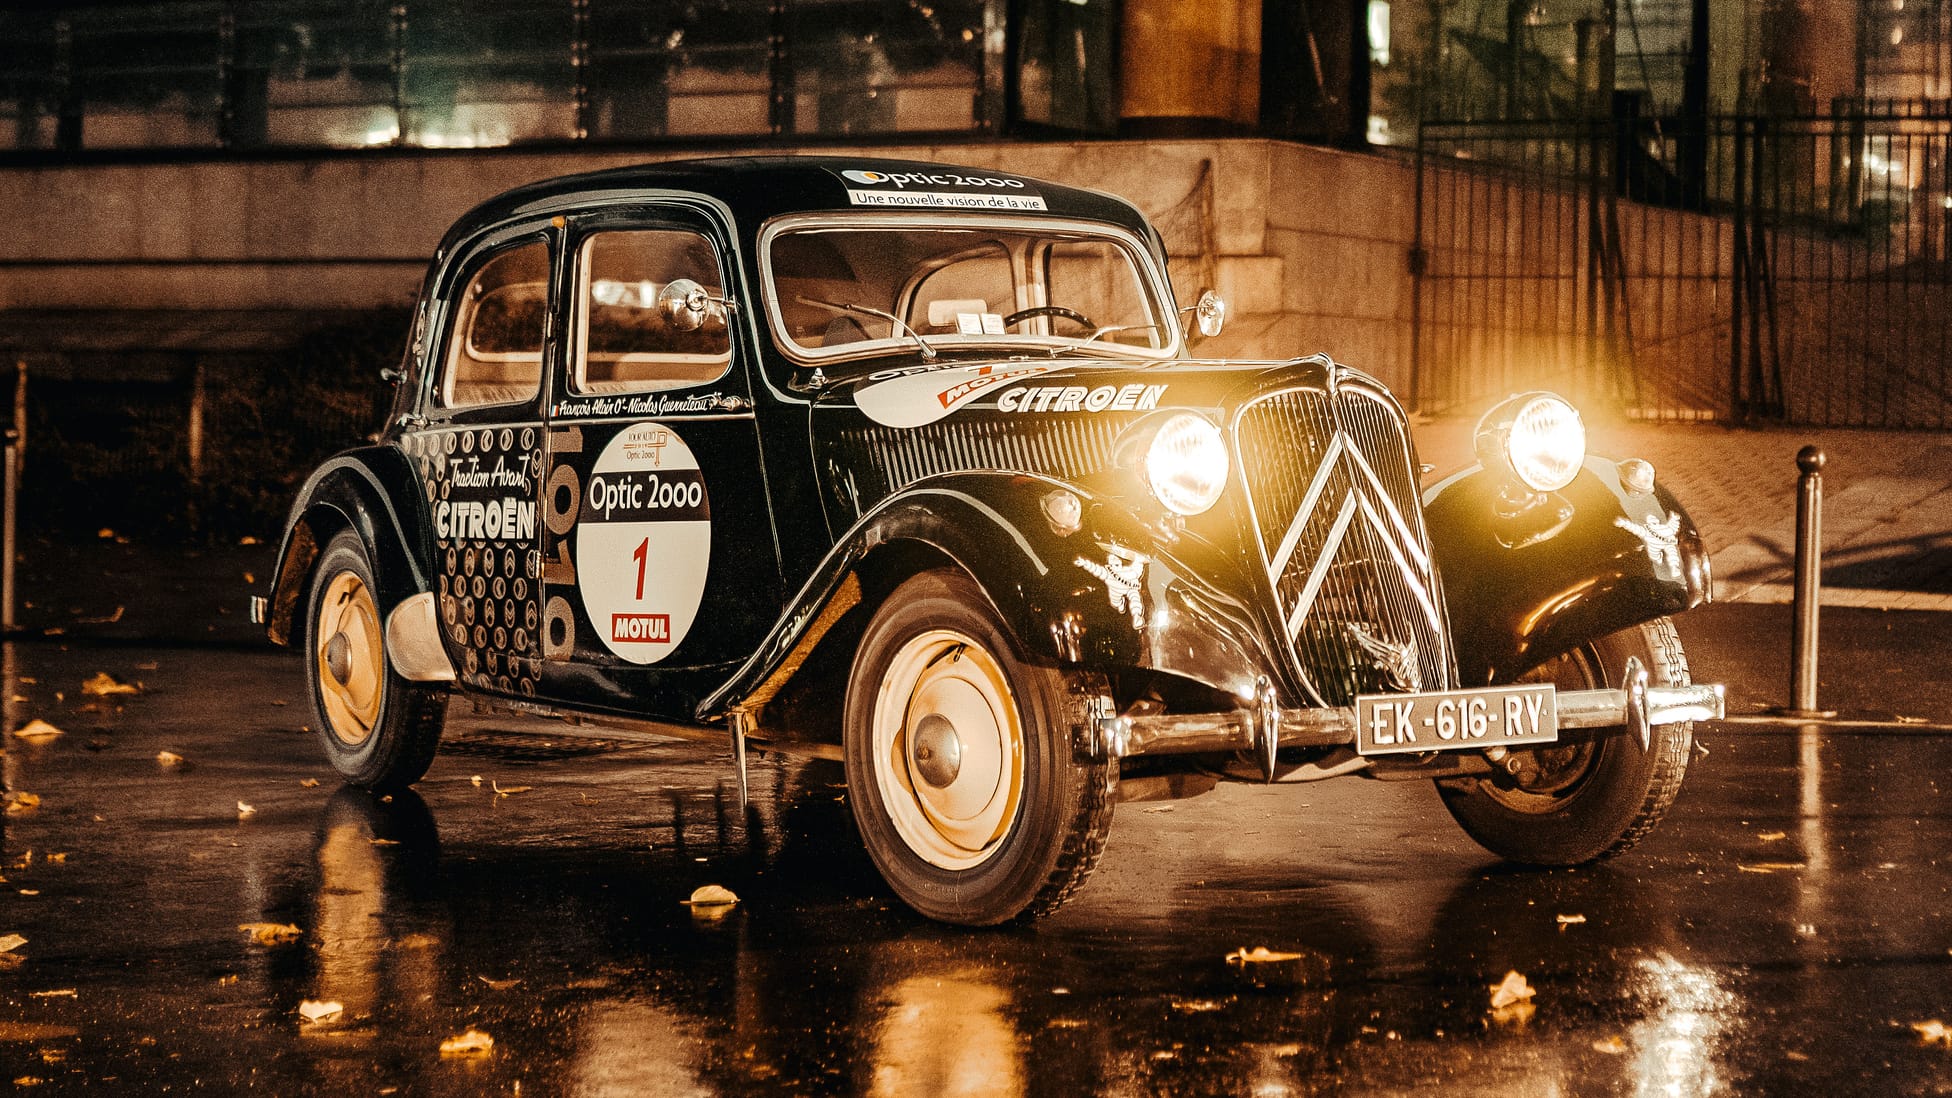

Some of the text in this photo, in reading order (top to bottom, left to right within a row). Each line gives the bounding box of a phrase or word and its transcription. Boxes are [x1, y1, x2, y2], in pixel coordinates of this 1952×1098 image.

[856, 192, 1040, 209] Une nouvelle vision de la vie
[559, 399, 591, 416] François
[592, 398, 614, 415] Allain
[628, 394, 658, 414] Nicolas
[997, 383, 1169, 413] CITROËN
[450, 453, 531, 488] Traction Avant
[590, 474, 702, 520] Optic 2000
[437, 496, 536, 539] CITROËN
[632, 536, 650, 600] 1
[614, 617, 668, 639] MOTUL
